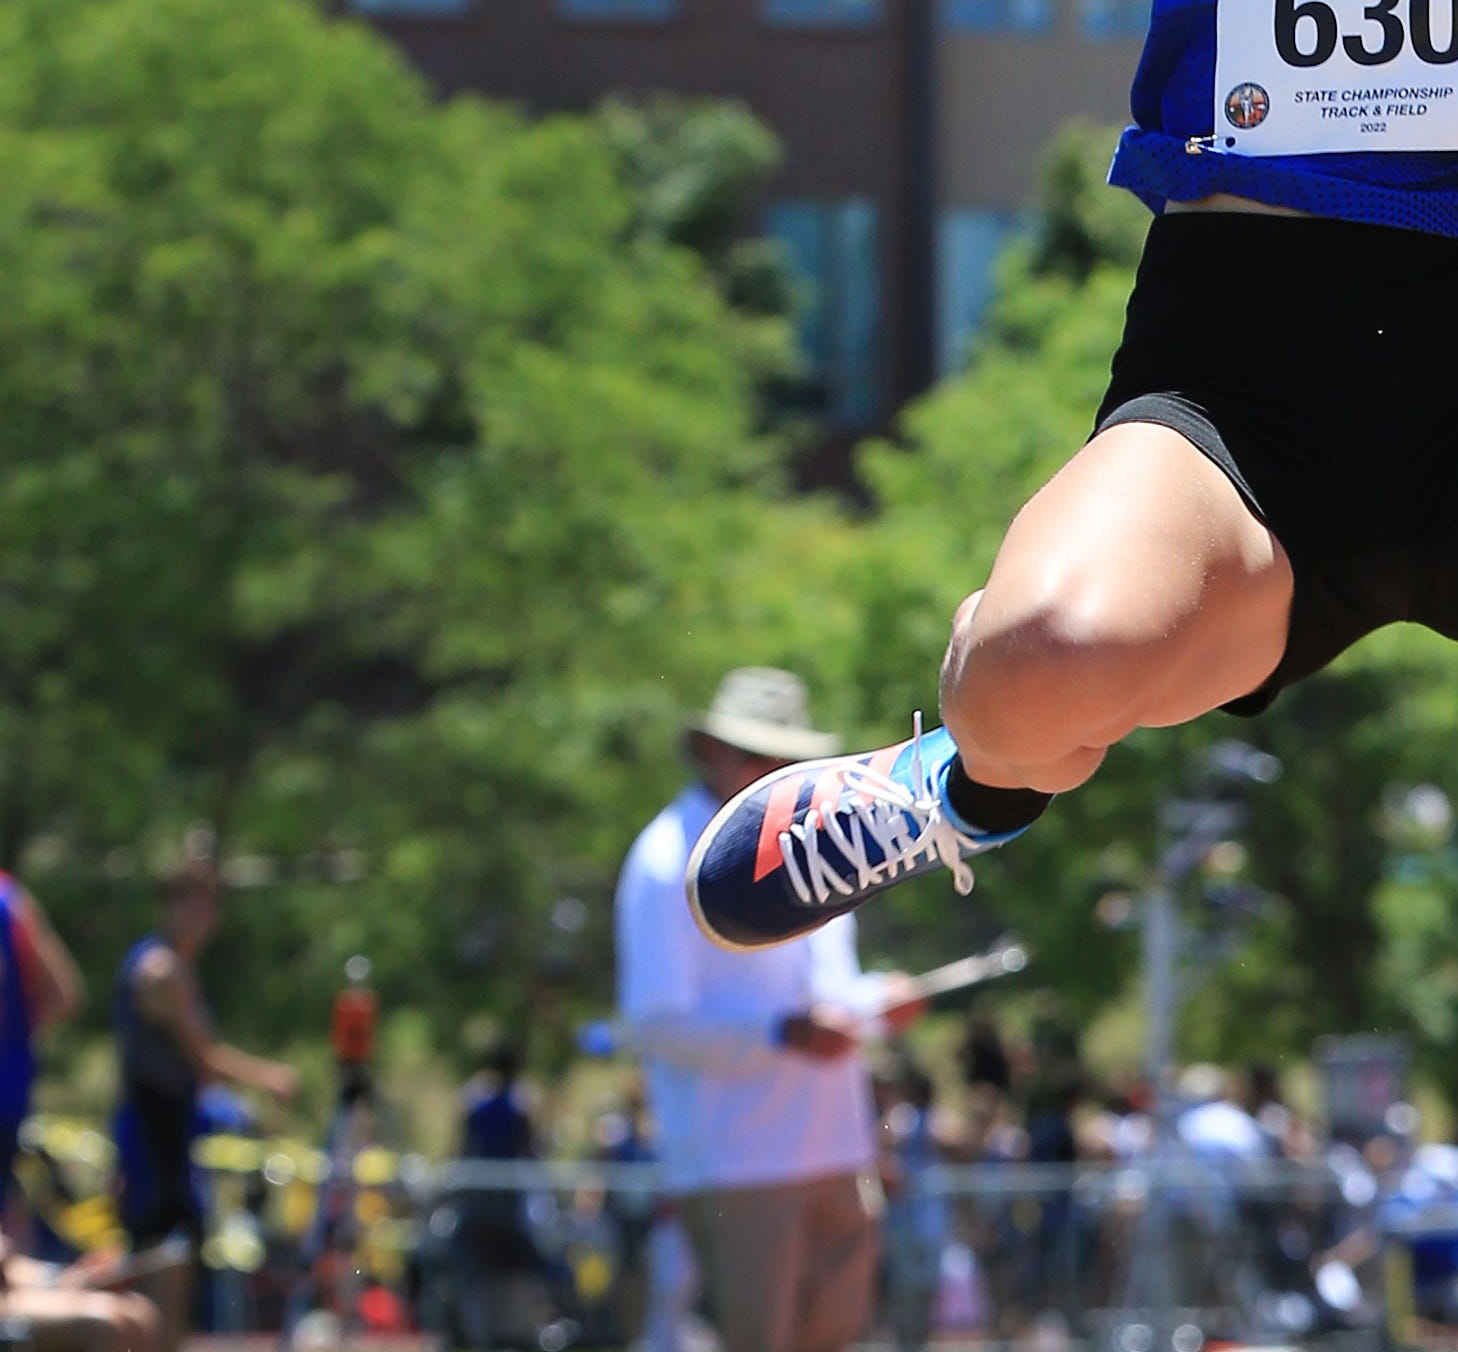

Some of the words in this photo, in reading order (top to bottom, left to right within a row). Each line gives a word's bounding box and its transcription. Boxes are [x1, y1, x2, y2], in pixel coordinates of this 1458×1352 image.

[1295, 91, 1337, 103] STATE
[1342, 87, 1453, 102] CHAMPIONSHIP
[1320, 106, 1368, 119] TRACK
[1373, 105, 1382, 117] &
[1387, 104, 1427, 116] FIELD
[1361, 123, 1387, 133] 2022
